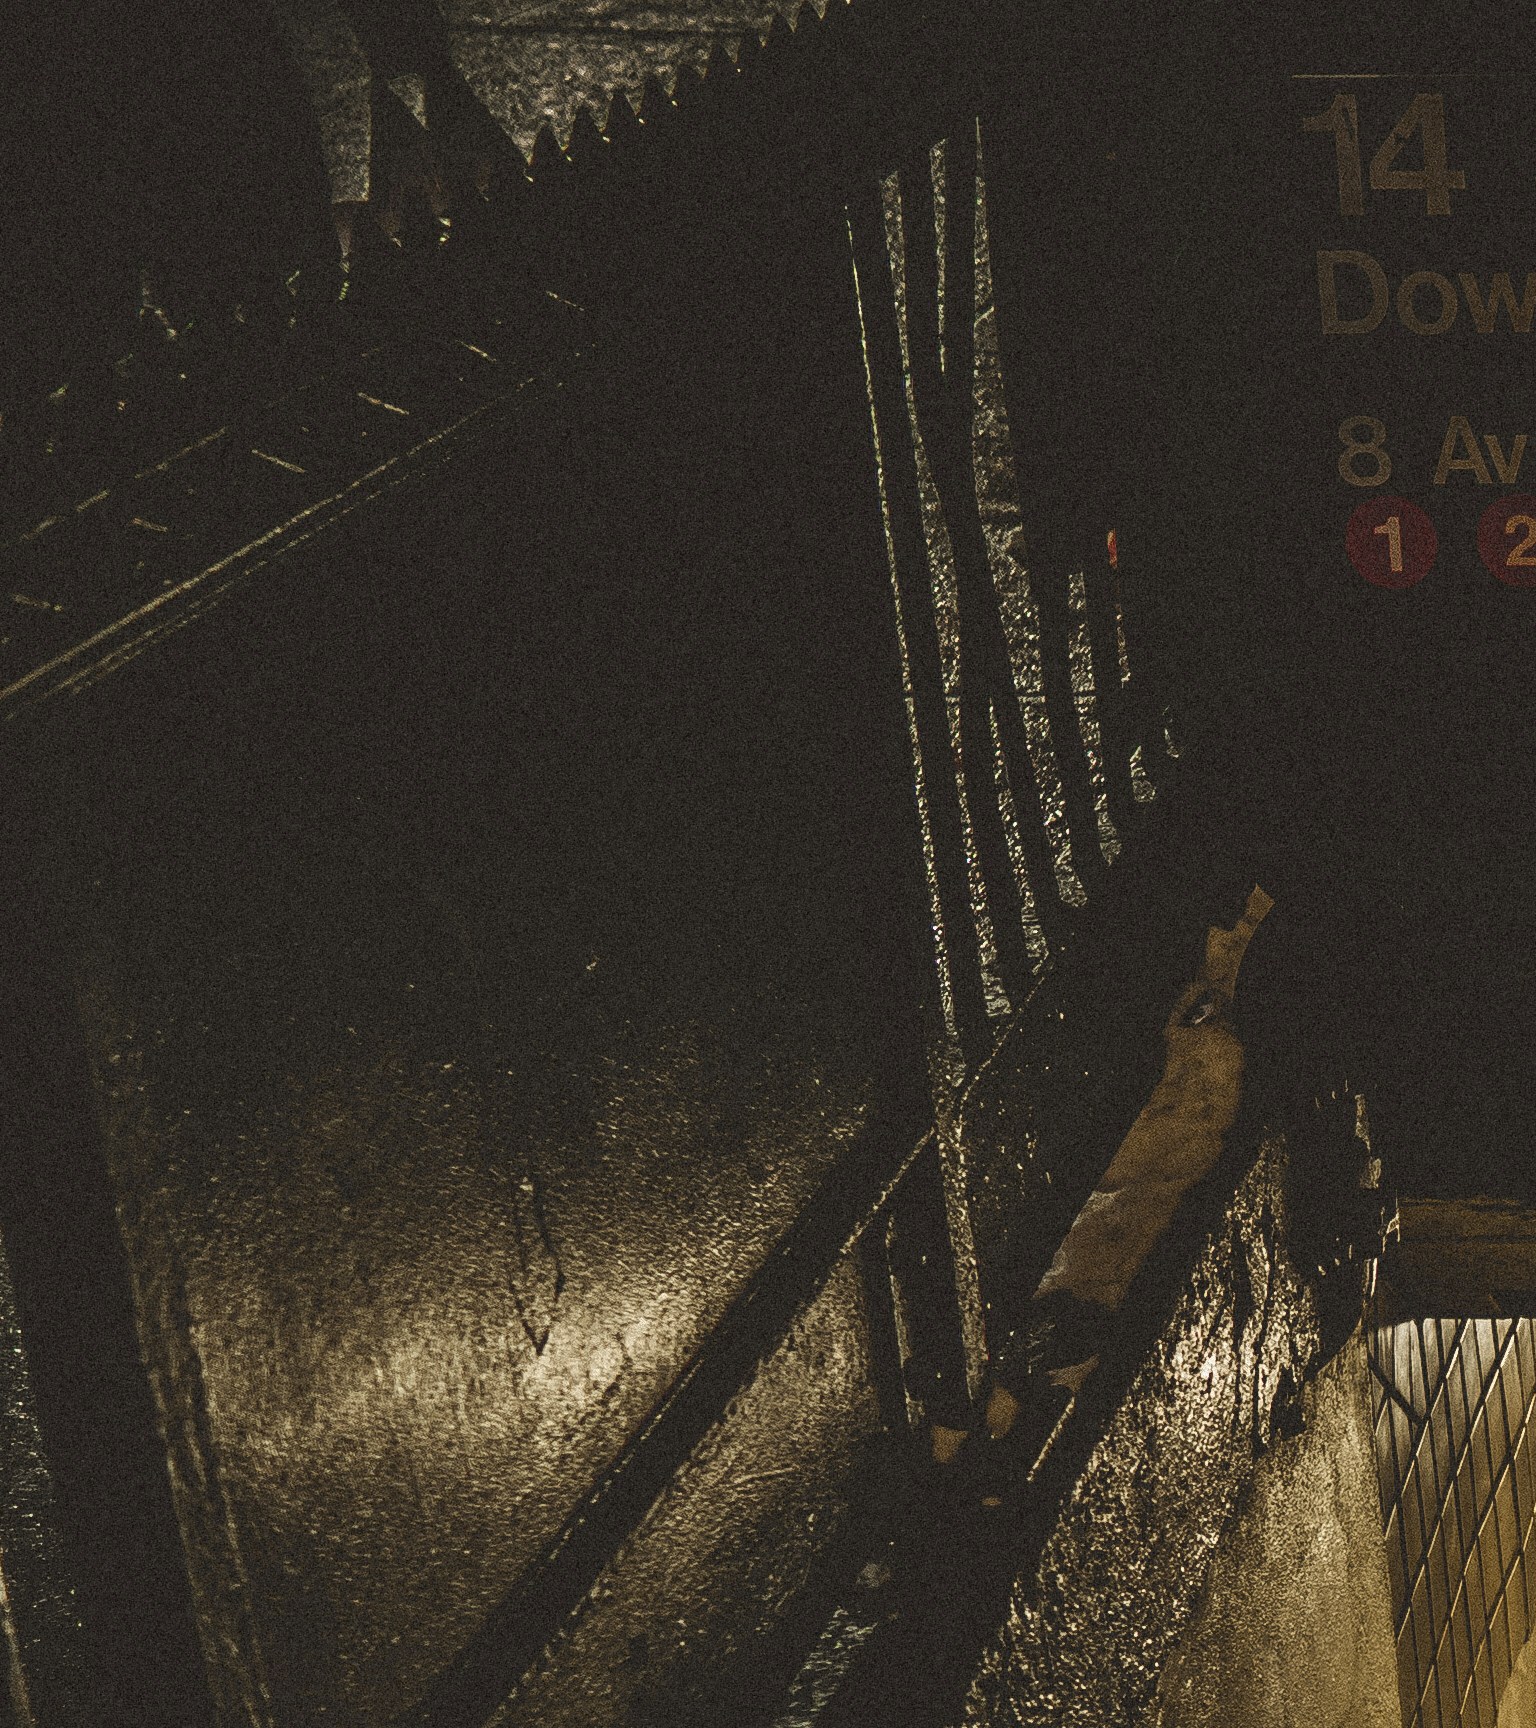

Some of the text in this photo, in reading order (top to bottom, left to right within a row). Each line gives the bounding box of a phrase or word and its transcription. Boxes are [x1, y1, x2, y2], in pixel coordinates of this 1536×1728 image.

[1304, 93, 1467, 215] 14
[1339, 417, 1391, 487] 8
[1374, 515, 1404, 573] 1
